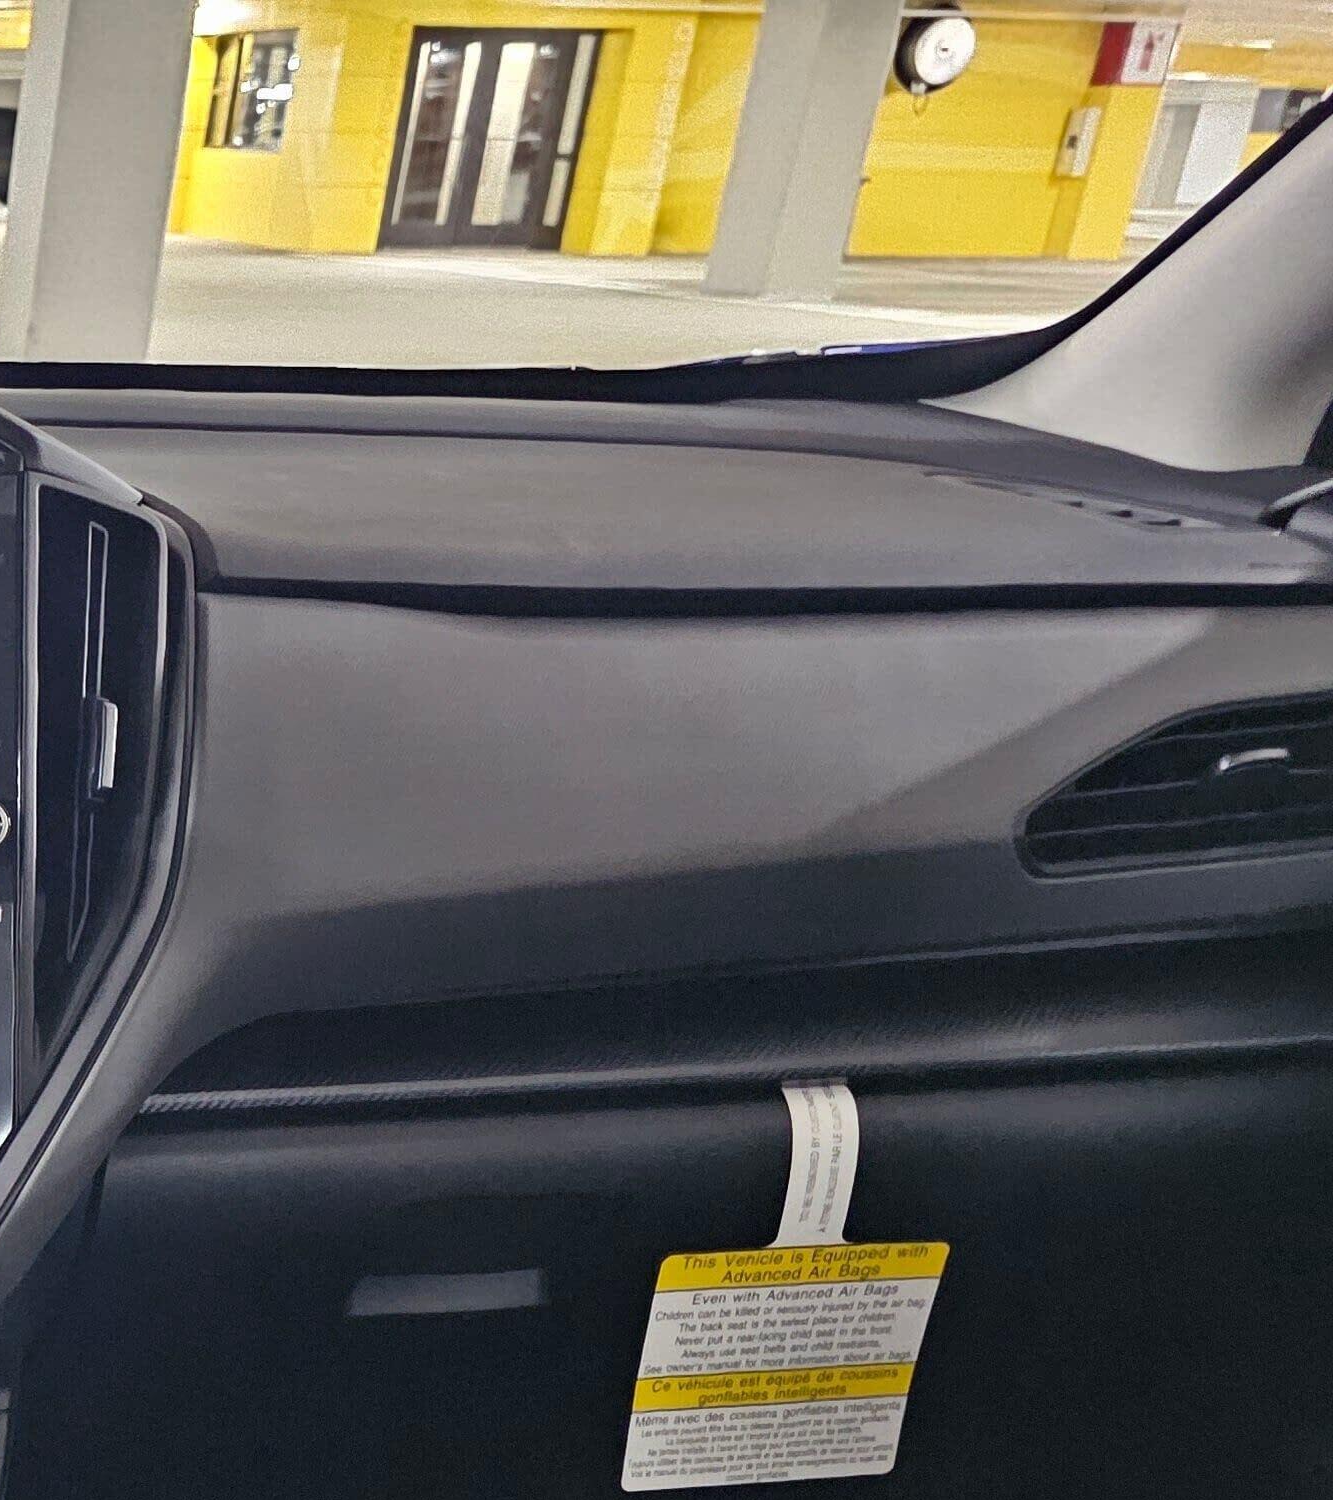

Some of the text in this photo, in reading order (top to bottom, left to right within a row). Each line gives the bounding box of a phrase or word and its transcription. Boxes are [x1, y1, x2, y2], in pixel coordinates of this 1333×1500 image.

[684, 1246, 928, 1269] This Vehicle is Equipped with
[721, 1264, 881, 1283] Advanced Air Bags
[693, 1284, 899, 1305] Even with Advanced Air Bags
[655, 1310, 693, 1320] Children
[719, 1308, 731, 1317] be
[857, 1301, 869, 1311] by
[679, 1323, 696, 1333] The
[700, 1322, 722, 1332] back
[707, 1335, 723, 1346] put
[652, 1380, 671, 1393] Ce
[739, 1377, 760, 1388] est
[817, 1371, 834, 1383] de
[840, 1369, 899, 1381] coussins
[698, 1384, 846, 1407] gonflables intelligents
[673, 1415, 700, 1425] avec
[705, 1412, 724, 1423] des
